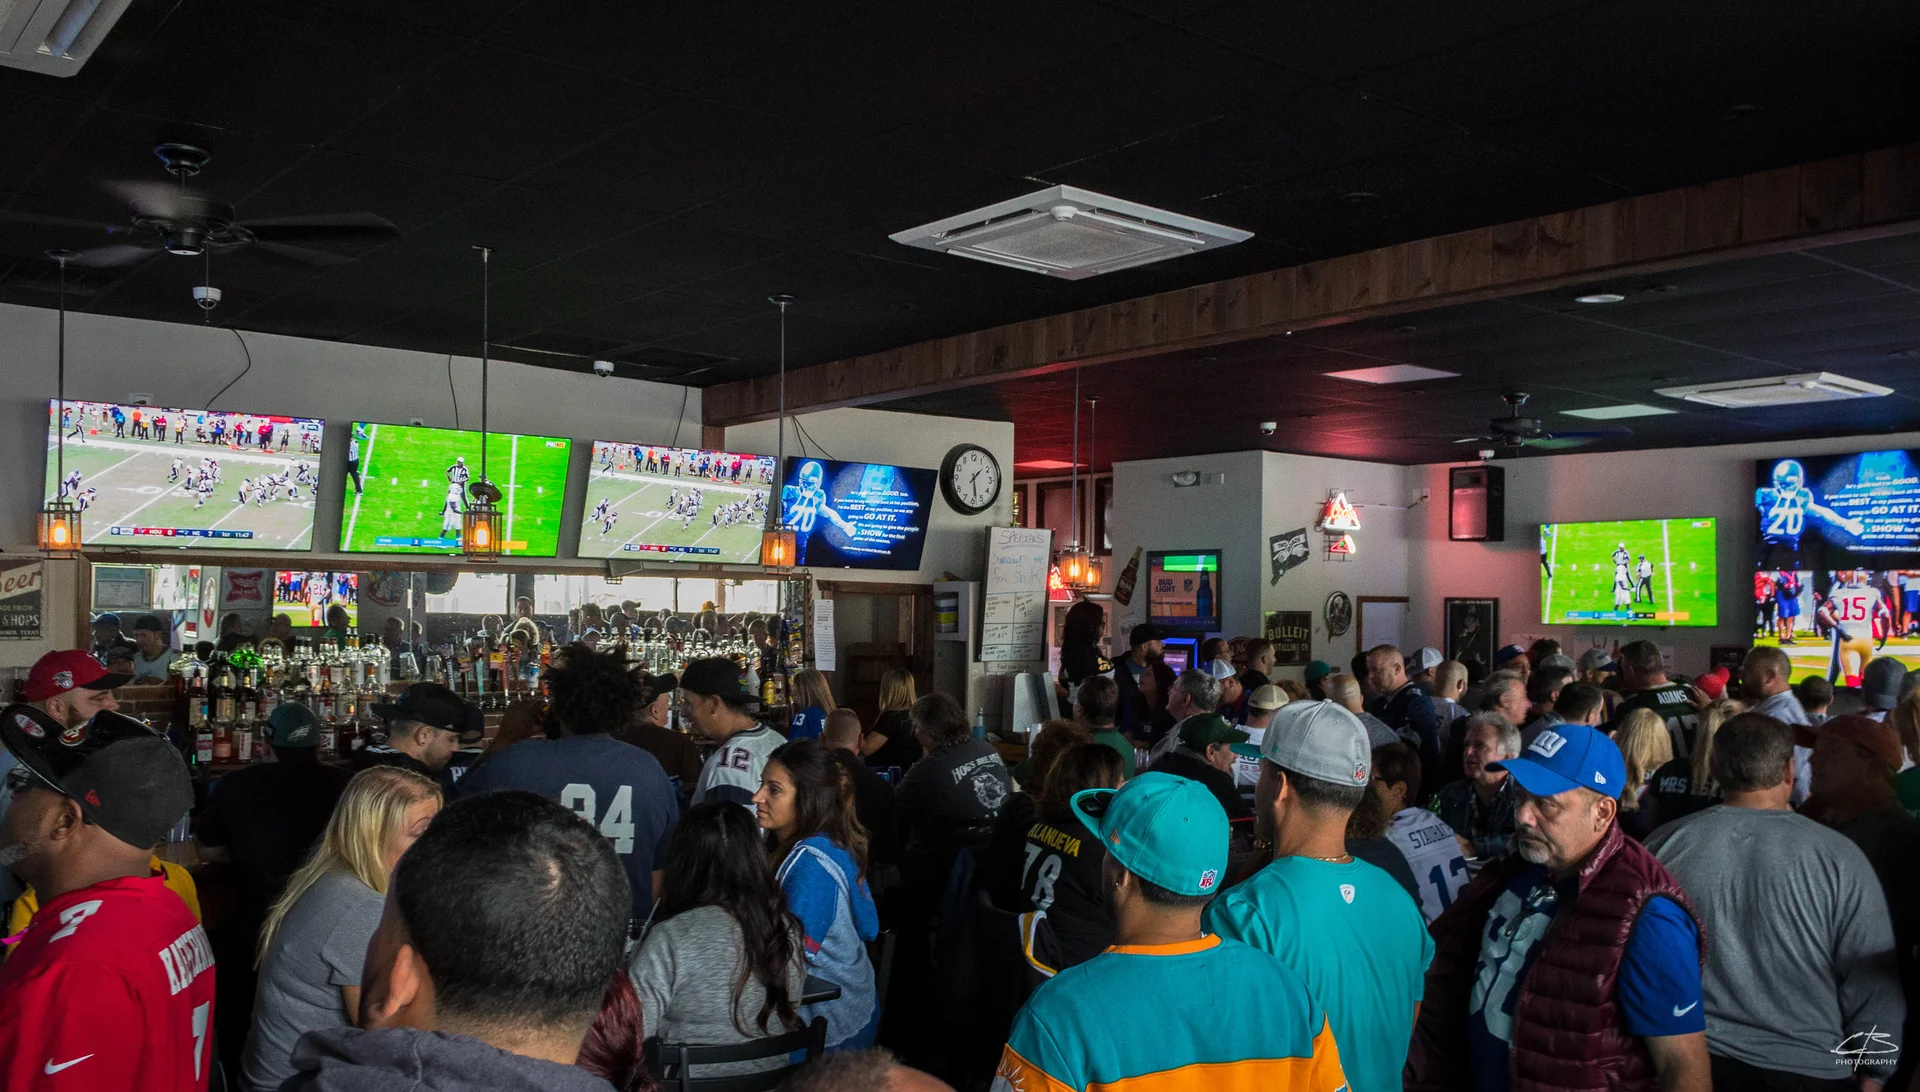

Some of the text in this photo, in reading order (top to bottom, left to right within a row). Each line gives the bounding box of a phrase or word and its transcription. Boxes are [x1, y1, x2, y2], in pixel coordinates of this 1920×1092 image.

[1871, 506, 1888, 515] GO
[1890, 505, 1906, 514] AT
[1767, 507, 1803, 535] 20
[861, 529, 882, 537] SHOW
[0, 570, 42, 593] eer
[1156, 585, 1176, 593] LIGHT
[1158, 578, 1173, 586] BUD
[1840, 597, 1867, 621] 15
[11, 614, 40, 627] HOPS
[1268, 626, 1309, 641] BULLEIT
[1656, 690, 1688, 705] ADAMS
[717, 746, 751, 773] 12
[1659, 776, 1688, 793] MRS
[1020, 841, 1063, 911] 78
[49, 900, 103, 944] 7
